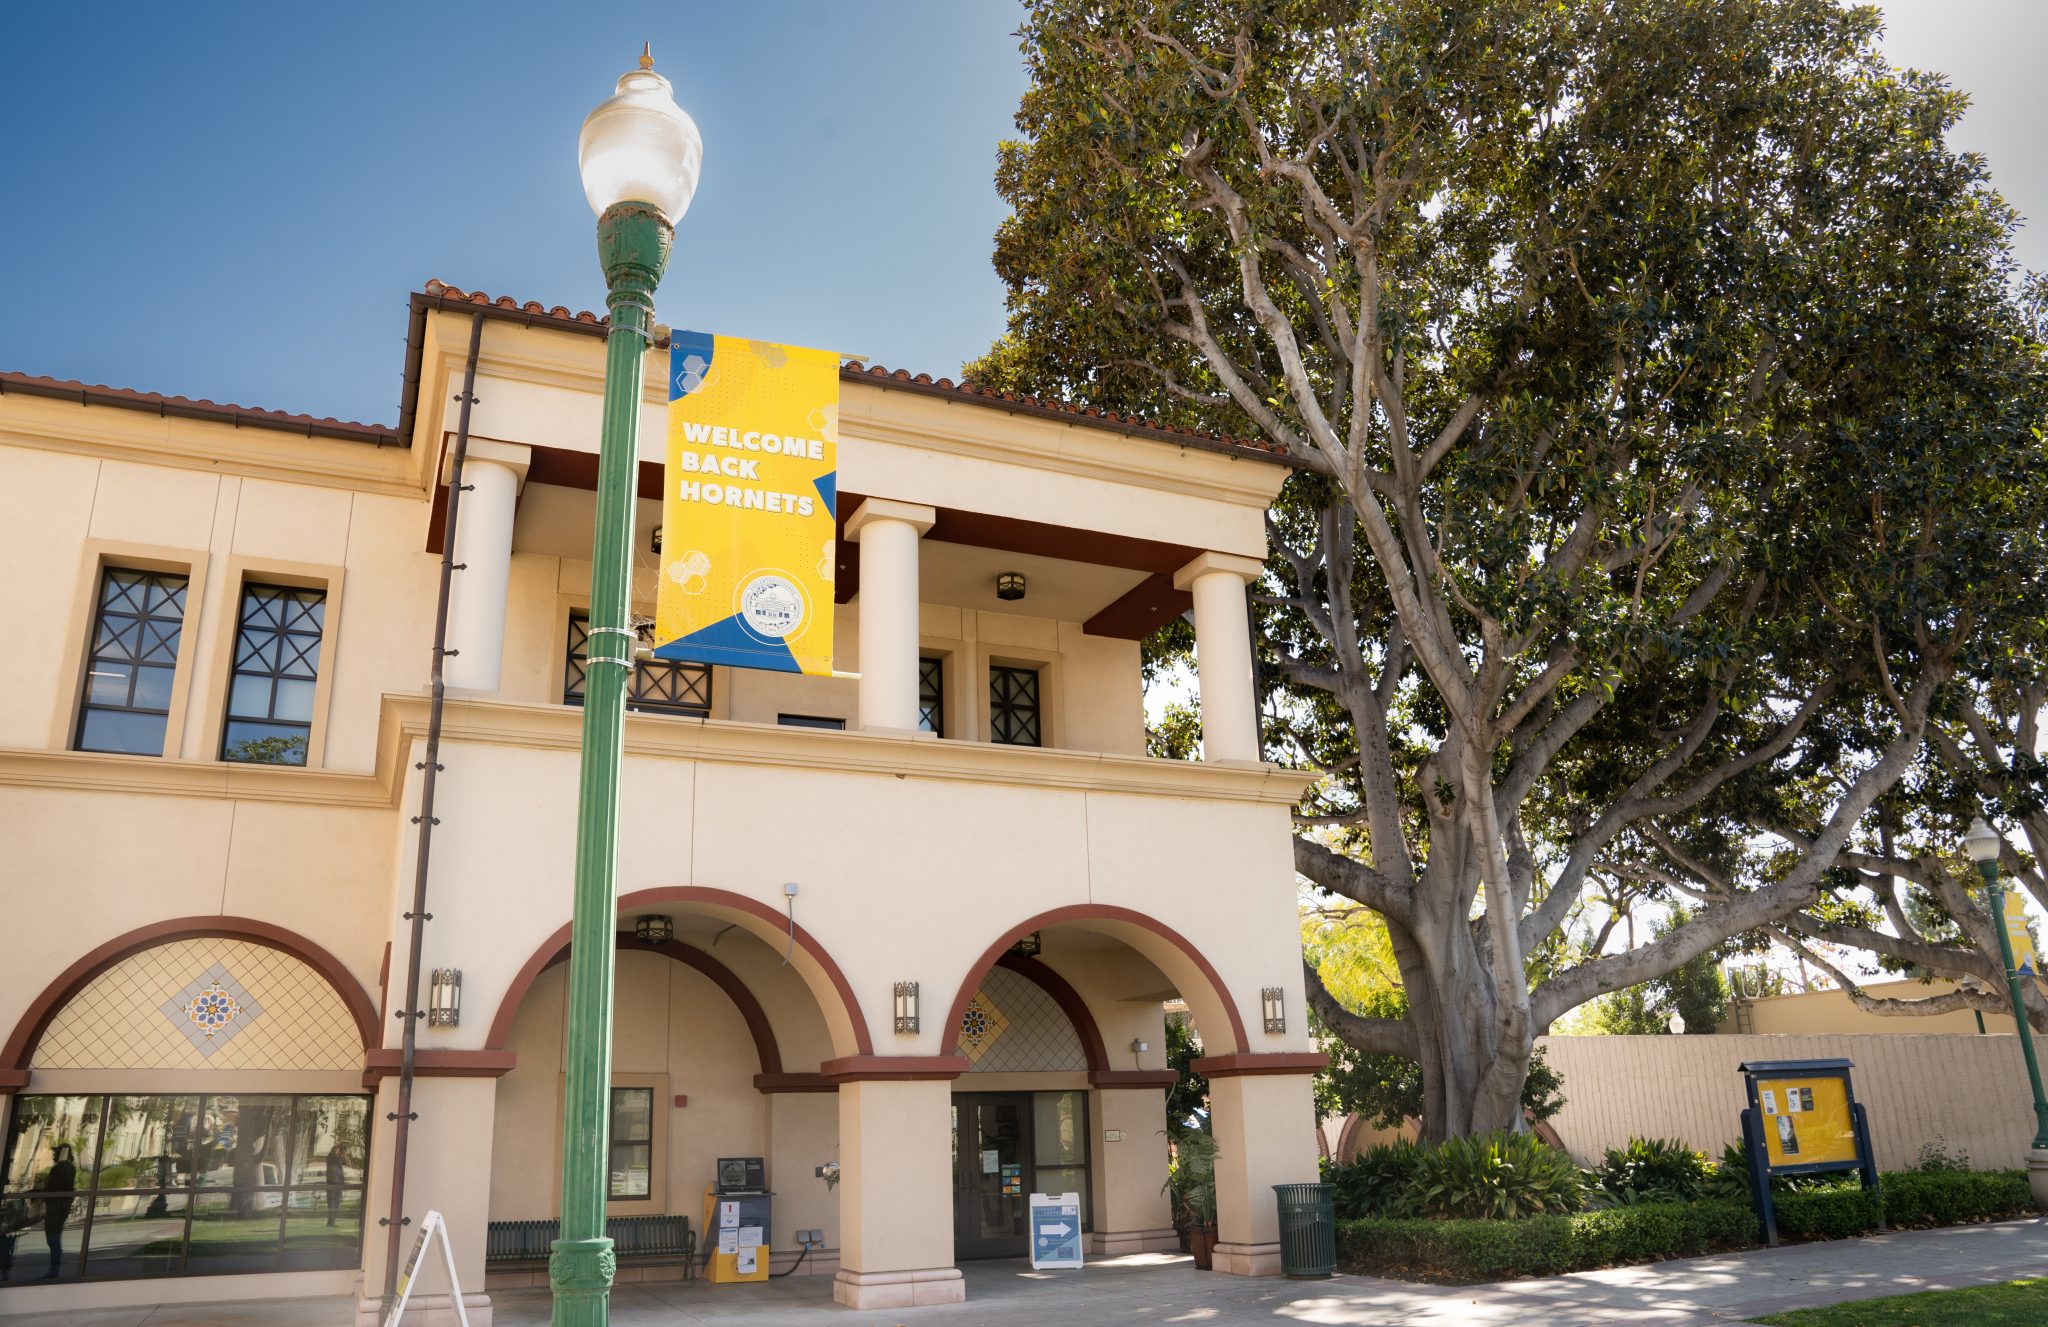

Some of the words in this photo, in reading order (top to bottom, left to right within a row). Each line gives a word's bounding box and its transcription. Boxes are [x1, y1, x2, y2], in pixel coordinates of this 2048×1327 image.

[683, 422, 824, 460] WELCOME
[682, 451, 760, 480] BACK
[680, 480, 814, 517] HORNETS
